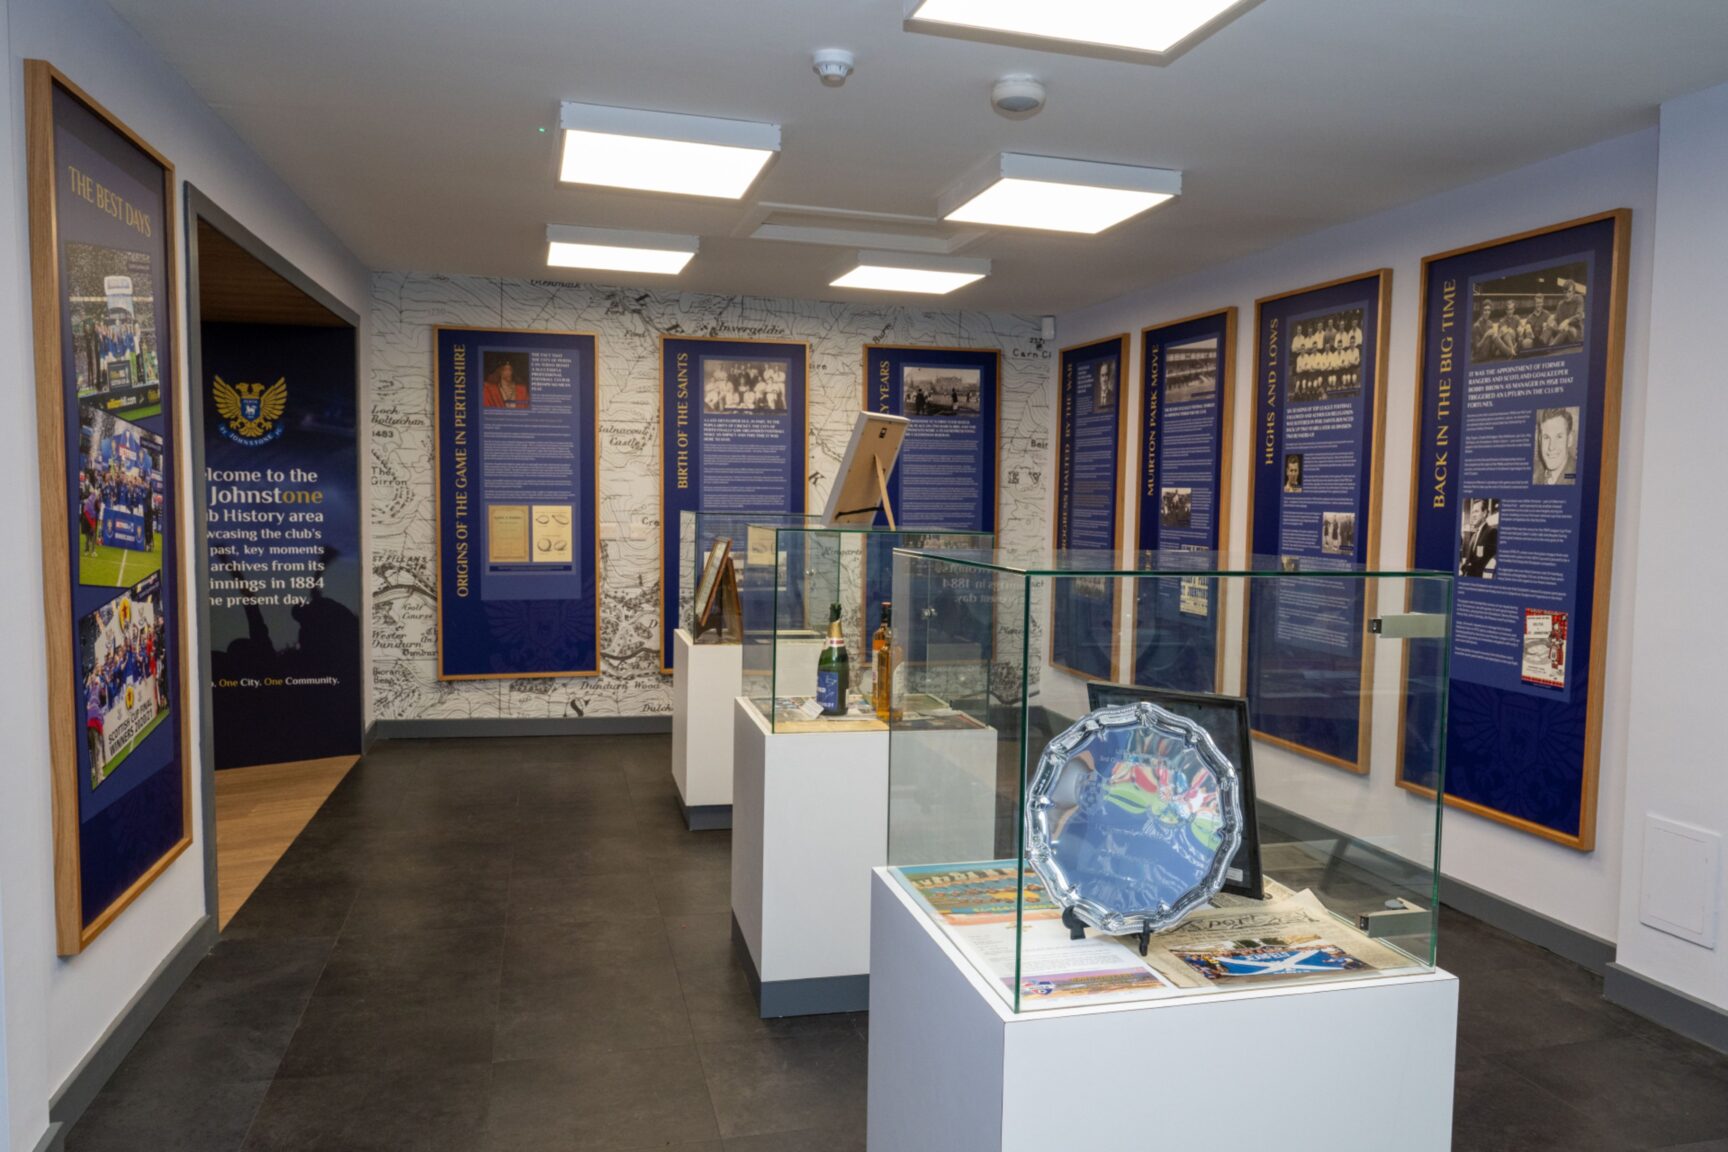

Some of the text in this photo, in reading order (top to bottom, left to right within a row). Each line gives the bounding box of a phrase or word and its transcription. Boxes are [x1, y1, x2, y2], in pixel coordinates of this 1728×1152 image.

[68, 165, 152, 238] THE BEST DAYS
[1012, 348, 1039, 359] Carn
[1151, 343, 1160, 387] MOVE
[1496, 363, 1533, 374] APPOINTMENT
[1533, 362, 1541, 370] OF
[1541, 360, 1566, 369] FORMER
[880, 360, 890, 401] YEARS
[1468, 368, 1569, 386] RANGERS AND SCOTLAND GOALKEEPER
[1468, 385, 1485, 393] BOBBY
[1485, 384, 1504, 392] BROWN
[1512, 379, 1539, 388] MANAGER
[1559, 376, 1574, 385] THAT
[1265, 317, 1279, 465] HIGHS AND LOWS
[1433, 279, 1456, 508] BACK IN THE BIG TIME
[1468, 392, 1496, 401] TRIGGERED
[1504, 389, 1525, 399] UPTURN
[1533, 387, 1543, 395] THE
[371, 404, 398, 415] Loch
[677, 352, 688, 489] BIRTH OF THE SAINTS
[229, 432, 273, 446] JOHNSTONE
[454, 343, 469, 598] ORIGINS OF THE GAME IN PERTHSHIRE
[1147, 430, 1157, 496] MUIRTON
[205, 467, 318, 482] lcome to the
[210, 486, 324, 506] Johnstone
[223, 509, 285, 525] History
[289, 513, 324, 522] area
[261, 528, 282, 539] the
[285, 528, 322, 539] club's
[210, 545, 325, 556] past, key moments
[210, 560, 325, 571] archives from its
[271, 577, 286, 589] in
[290, 577, 324, 589] 1884
[227, 596, 281, 608] present
[283, 594, 311, 608] day.
[372, 630, 407, 639] Wester
[219, 676, 340, 690] One City. One Community.
[109, 698, 153, 745] SCOTTISH CUP FINAL
[110, 726, 134, 756] WINNERS
